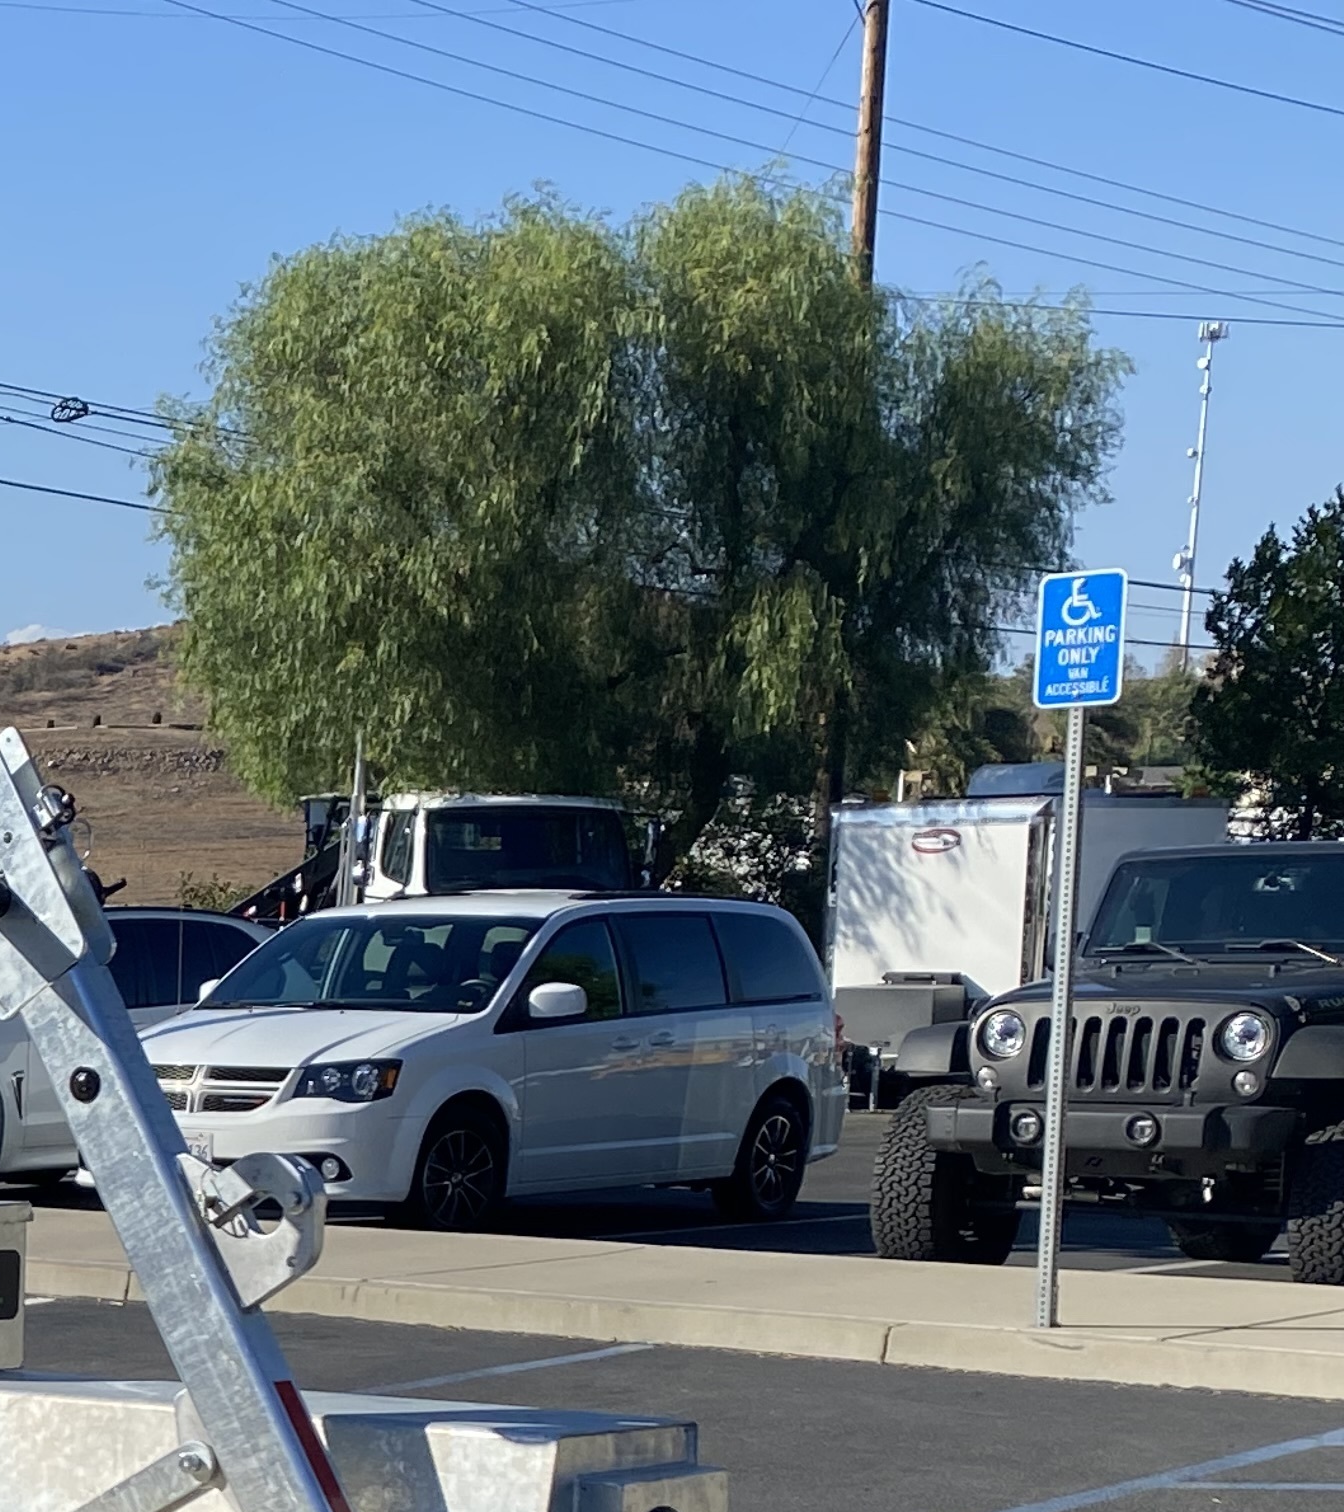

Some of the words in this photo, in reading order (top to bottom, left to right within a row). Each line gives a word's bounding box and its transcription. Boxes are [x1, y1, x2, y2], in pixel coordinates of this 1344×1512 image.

[1045, 625, 1116, 647] PARKING
[1058, 647, 1099, 666] ONLY
[1045, 679, 1109, 697] ACCESSIBLE
[1107, 1003, 1141, 1016] Jeep
[1318, 998, 1344, 1008] RU
